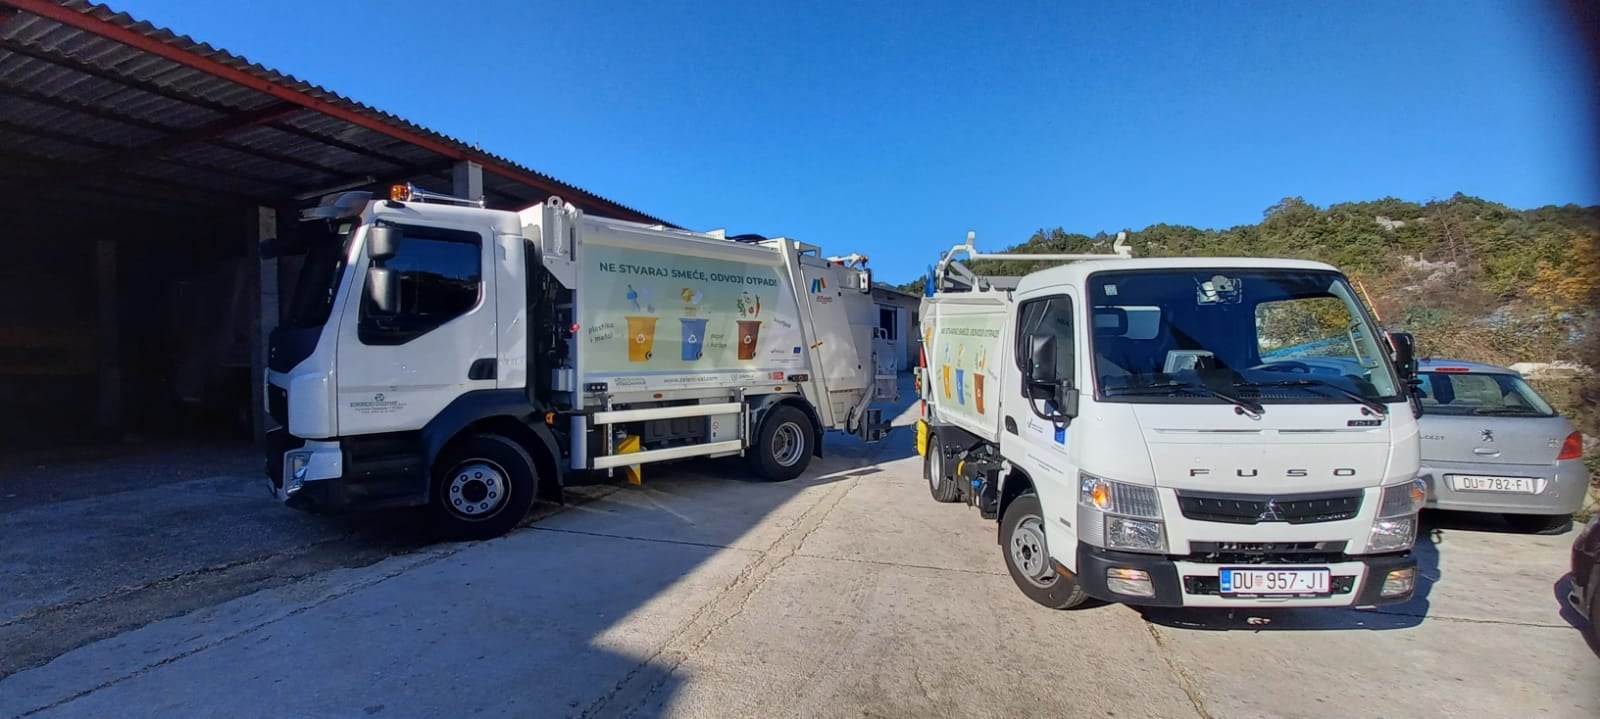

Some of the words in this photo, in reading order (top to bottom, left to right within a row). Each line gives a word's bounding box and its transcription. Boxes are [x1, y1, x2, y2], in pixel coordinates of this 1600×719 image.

[599, 261, 617, 273] NE
[618, 263, 669, 277] STVARAJ
[710, 273, 745, 284] ODVOJI
[1189, 468, 1357, 478] FUSO
[1463, 477, 1479, 489] DU
[1233, 572, 1254, 590] DU
[1267, 572, 1324, 590] 957-JI
